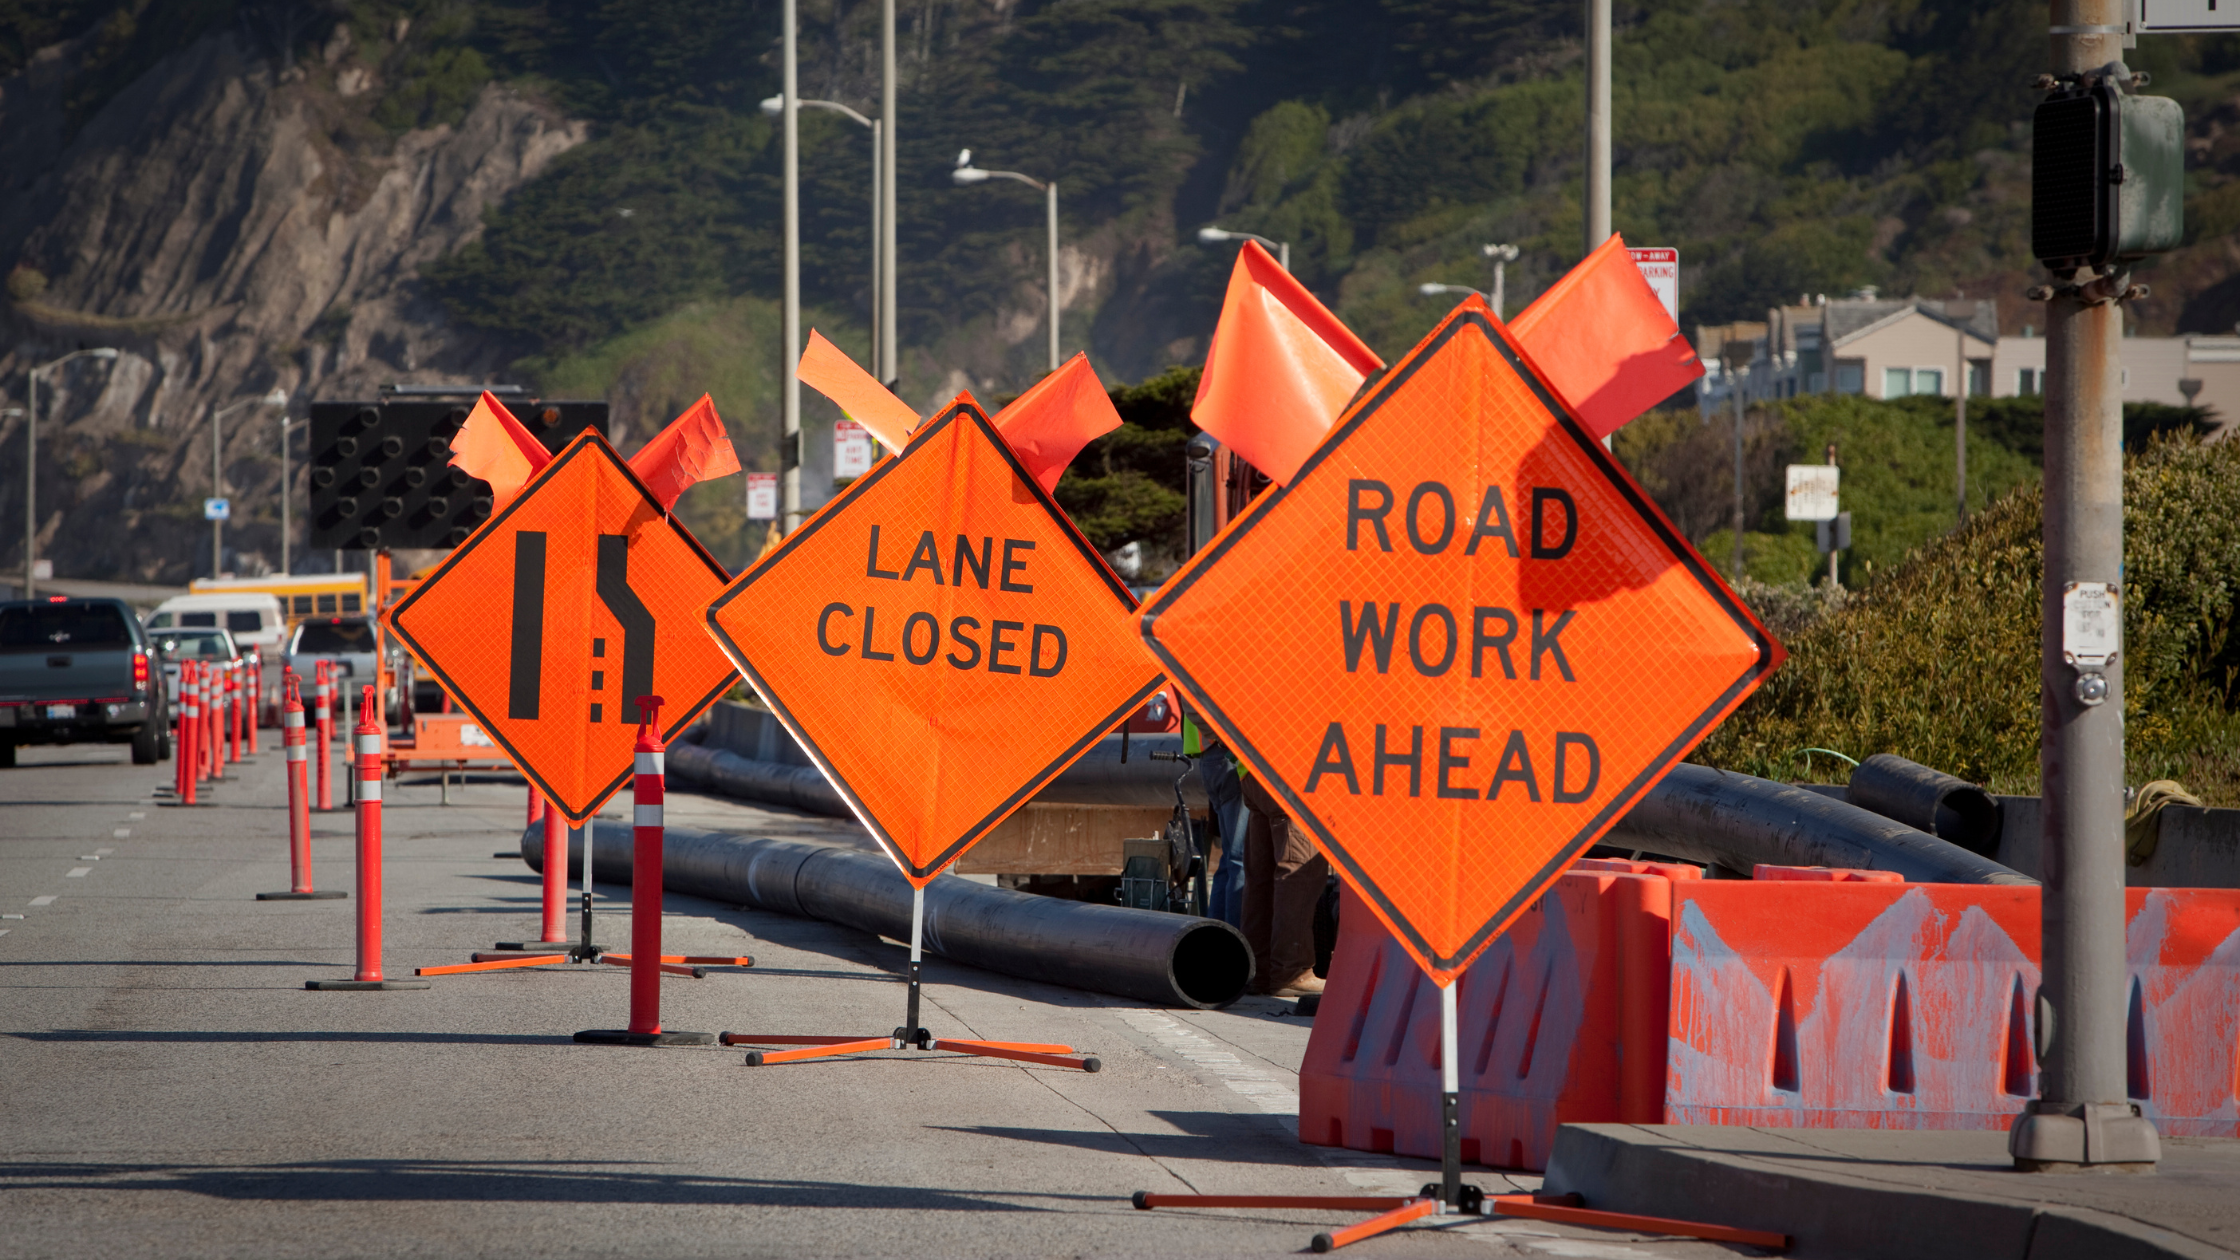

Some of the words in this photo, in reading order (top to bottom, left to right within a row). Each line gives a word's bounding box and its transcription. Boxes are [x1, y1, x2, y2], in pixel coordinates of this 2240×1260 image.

[1630, 252, 1670, 261] OW-AWAY
[1346, 479, 1579, 561] ROAD
[866, 524, 1036, 594] LANE
[2080, 590, 2106, 598] PUSH
[817, 602, 1068, 678] CLOSED
[1340, 600, 1577, 682] WORK
[1304, 722, 1601, 804] AHEAD
